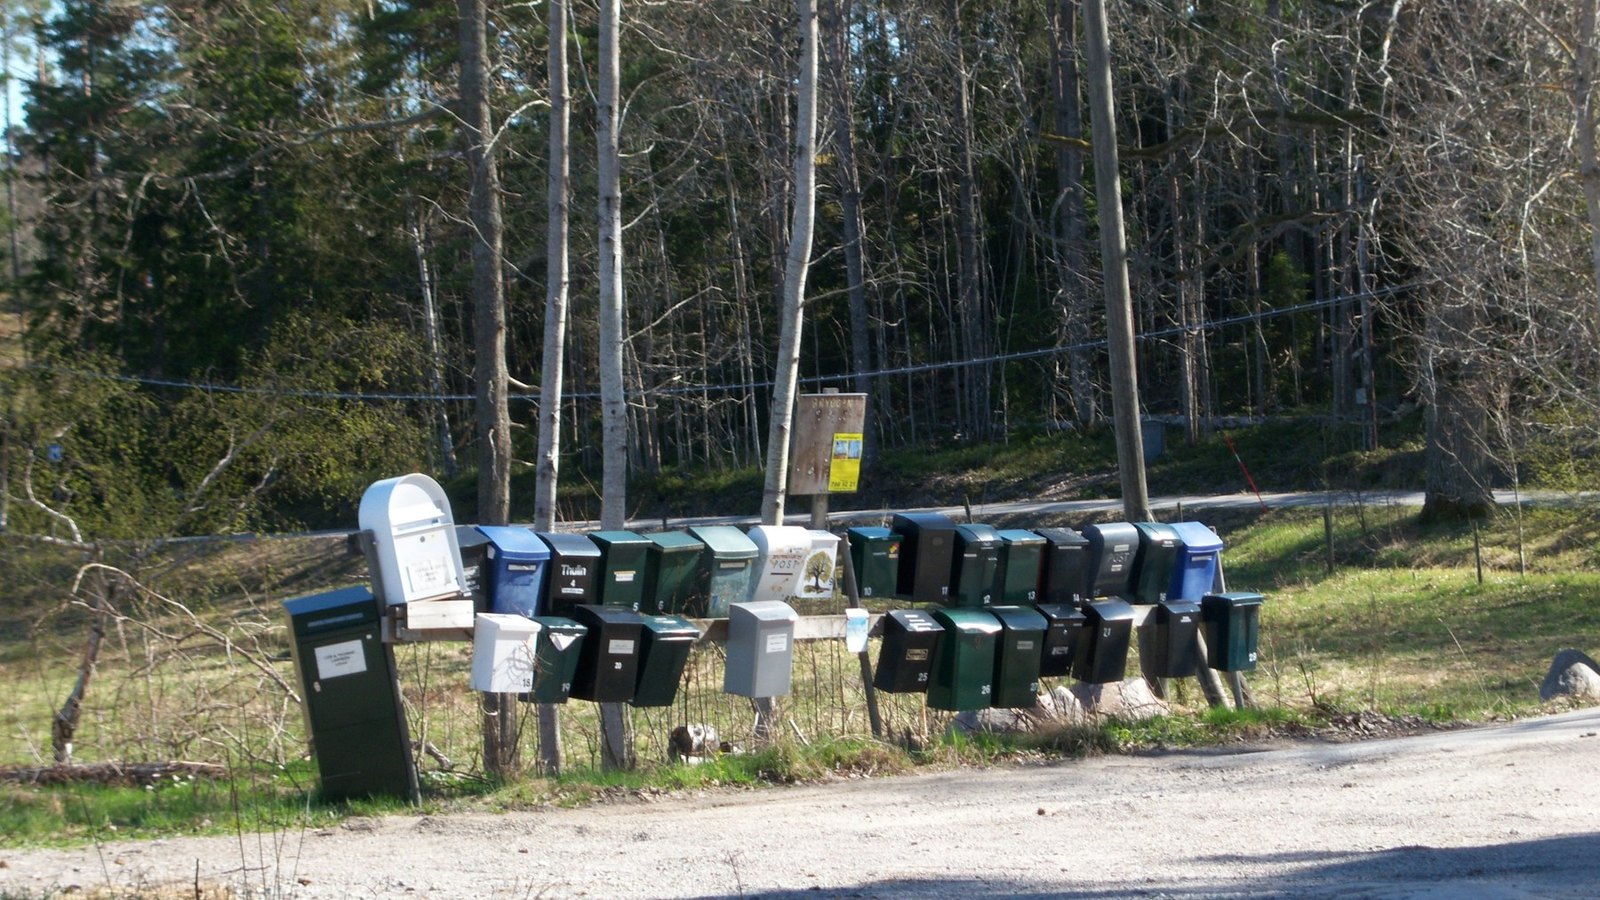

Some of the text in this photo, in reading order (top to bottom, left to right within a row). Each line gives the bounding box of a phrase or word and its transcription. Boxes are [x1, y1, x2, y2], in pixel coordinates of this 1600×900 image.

[773, 560, 798, 569] POST
[561, 564, 587, 576] Thulin
[570, 579, 576, 588] 4
[864, 587, 872, 596] 10
[1028, 591, 1036, 600] 13
[657, 600, 664, 610] 6
[983, 595, 991, 605] 12
[633, 602, 640, 612] 5
[614, 662, 622, 670] 20
[918, 672, 928, 682] 25
[522, 678, 531, 688] 18
[561, 682, 571, 692] 19
[981, 684, 991, 695] 26
